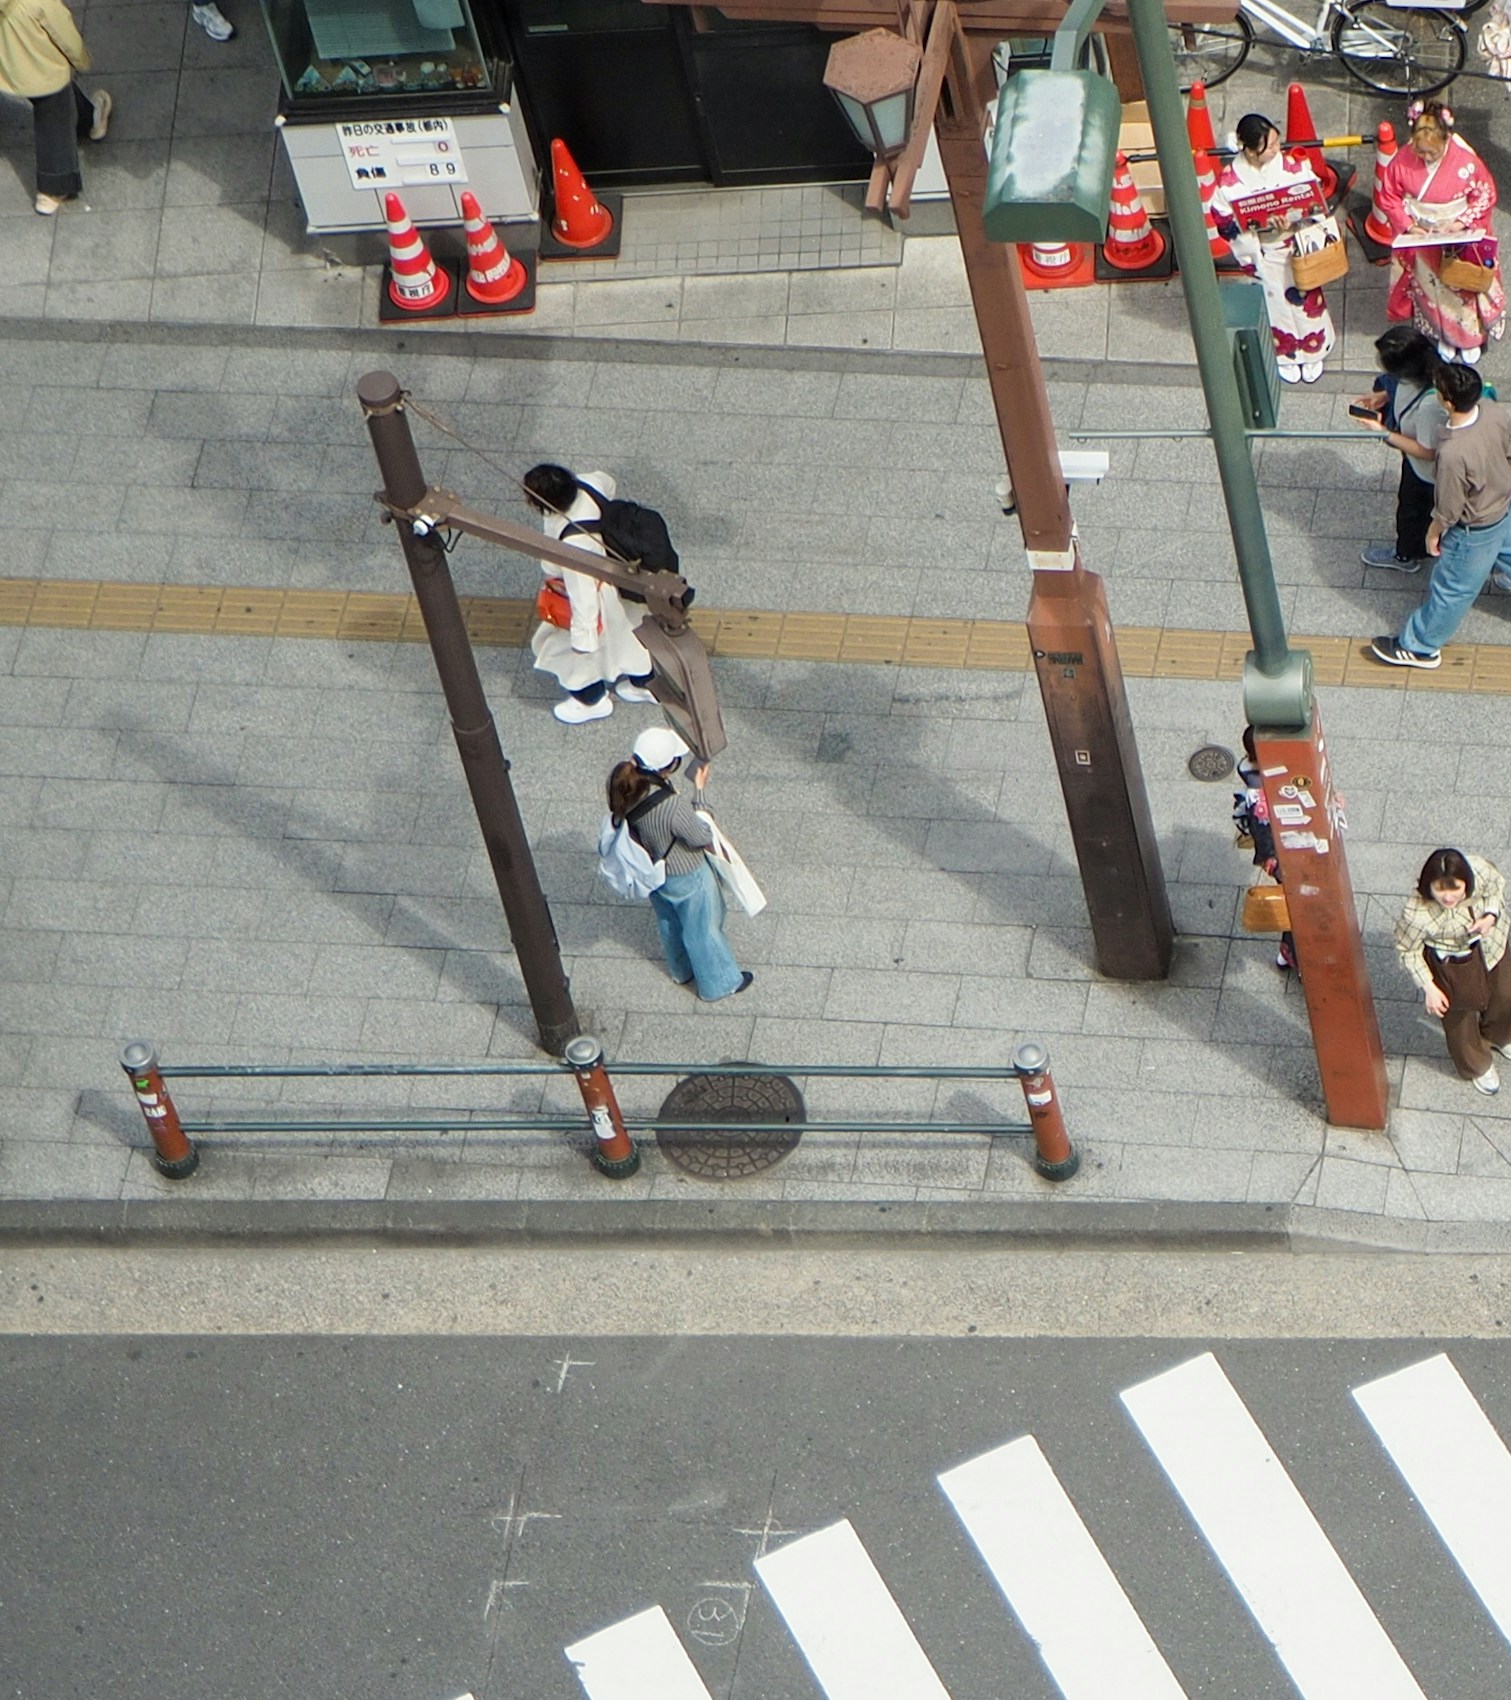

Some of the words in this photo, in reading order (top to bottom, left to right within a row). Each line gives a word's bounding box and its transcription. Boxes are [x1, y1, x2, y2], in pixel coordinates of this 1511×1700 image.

[348, 144, 380, 158] 死亡
[1240, 199, 1280, 215] Kimono
[1280, 190, 1315, 205] Rental
